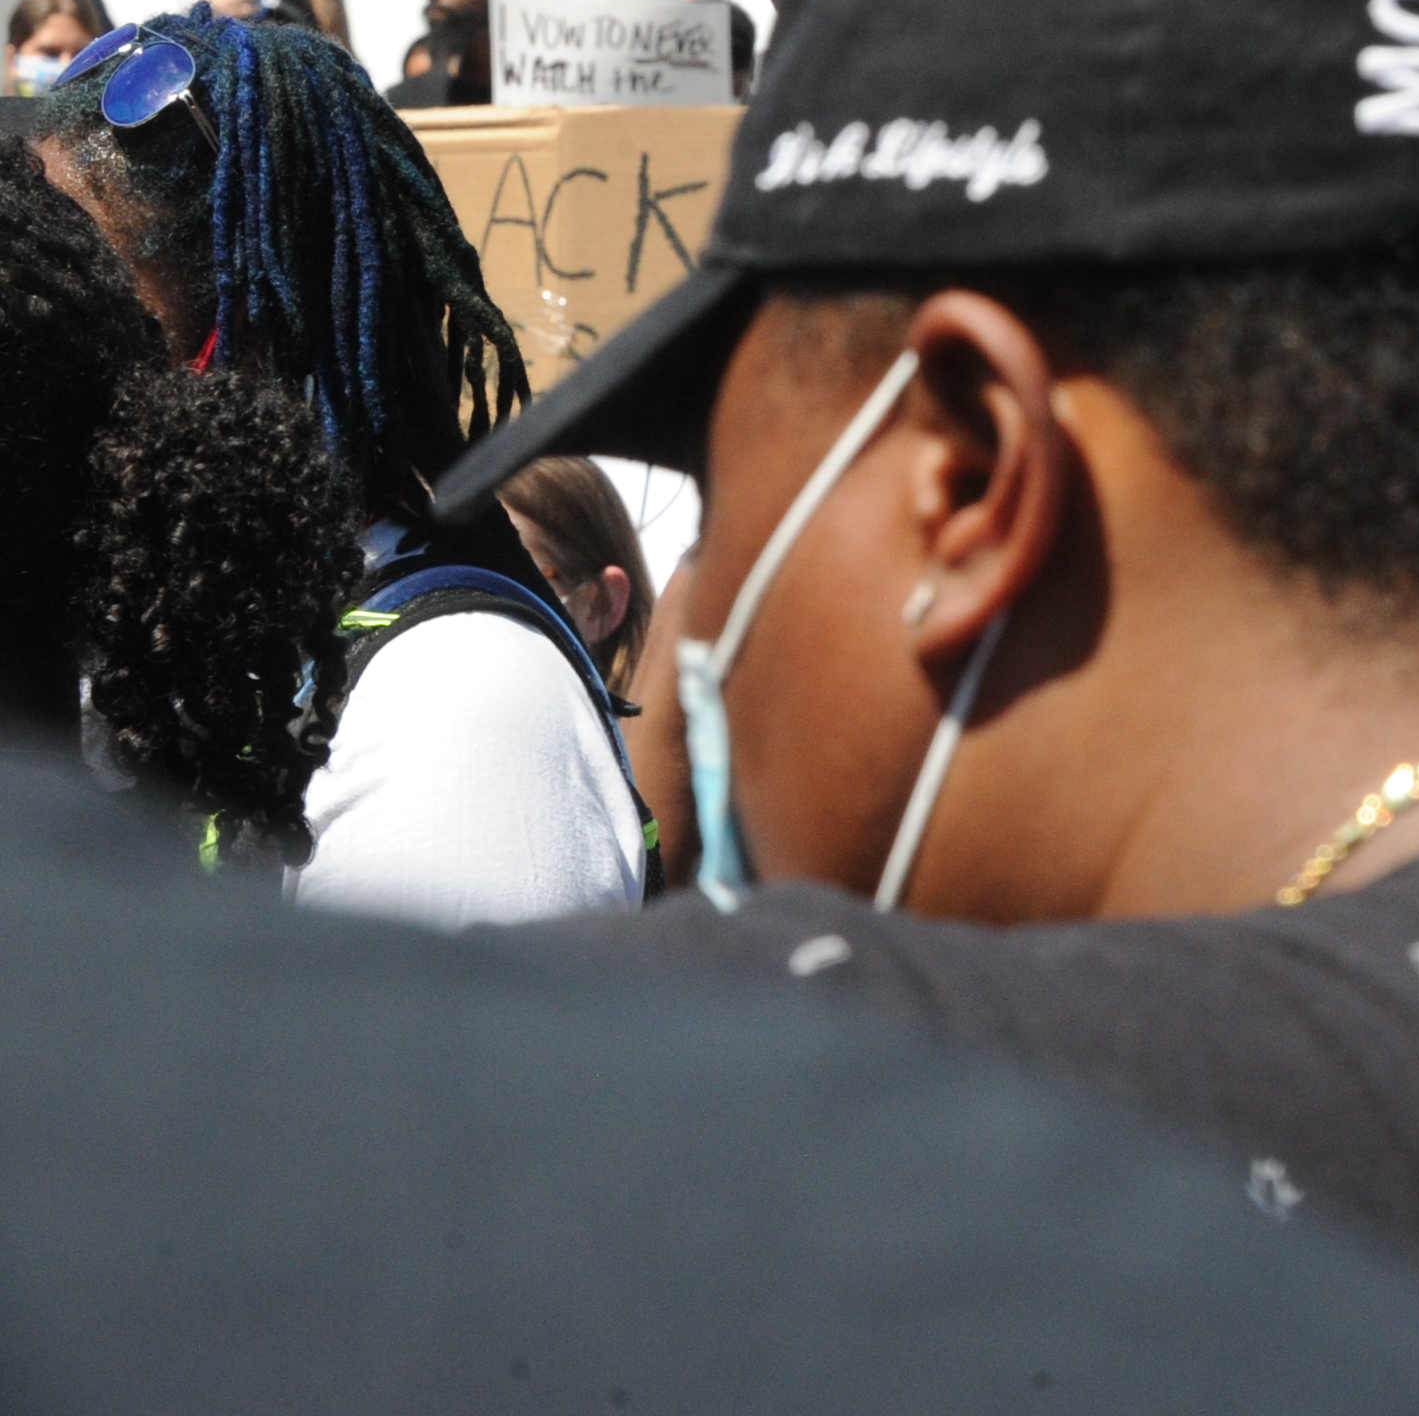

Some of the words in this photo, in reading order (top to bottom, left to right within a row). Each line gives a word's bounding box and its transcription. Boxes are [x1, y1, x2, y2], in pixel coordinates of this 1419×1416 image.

[521, 11, 584, 49] VOW
[500, 47, 597, 94] WATCH
[480, 150, 709, 295] ACK
